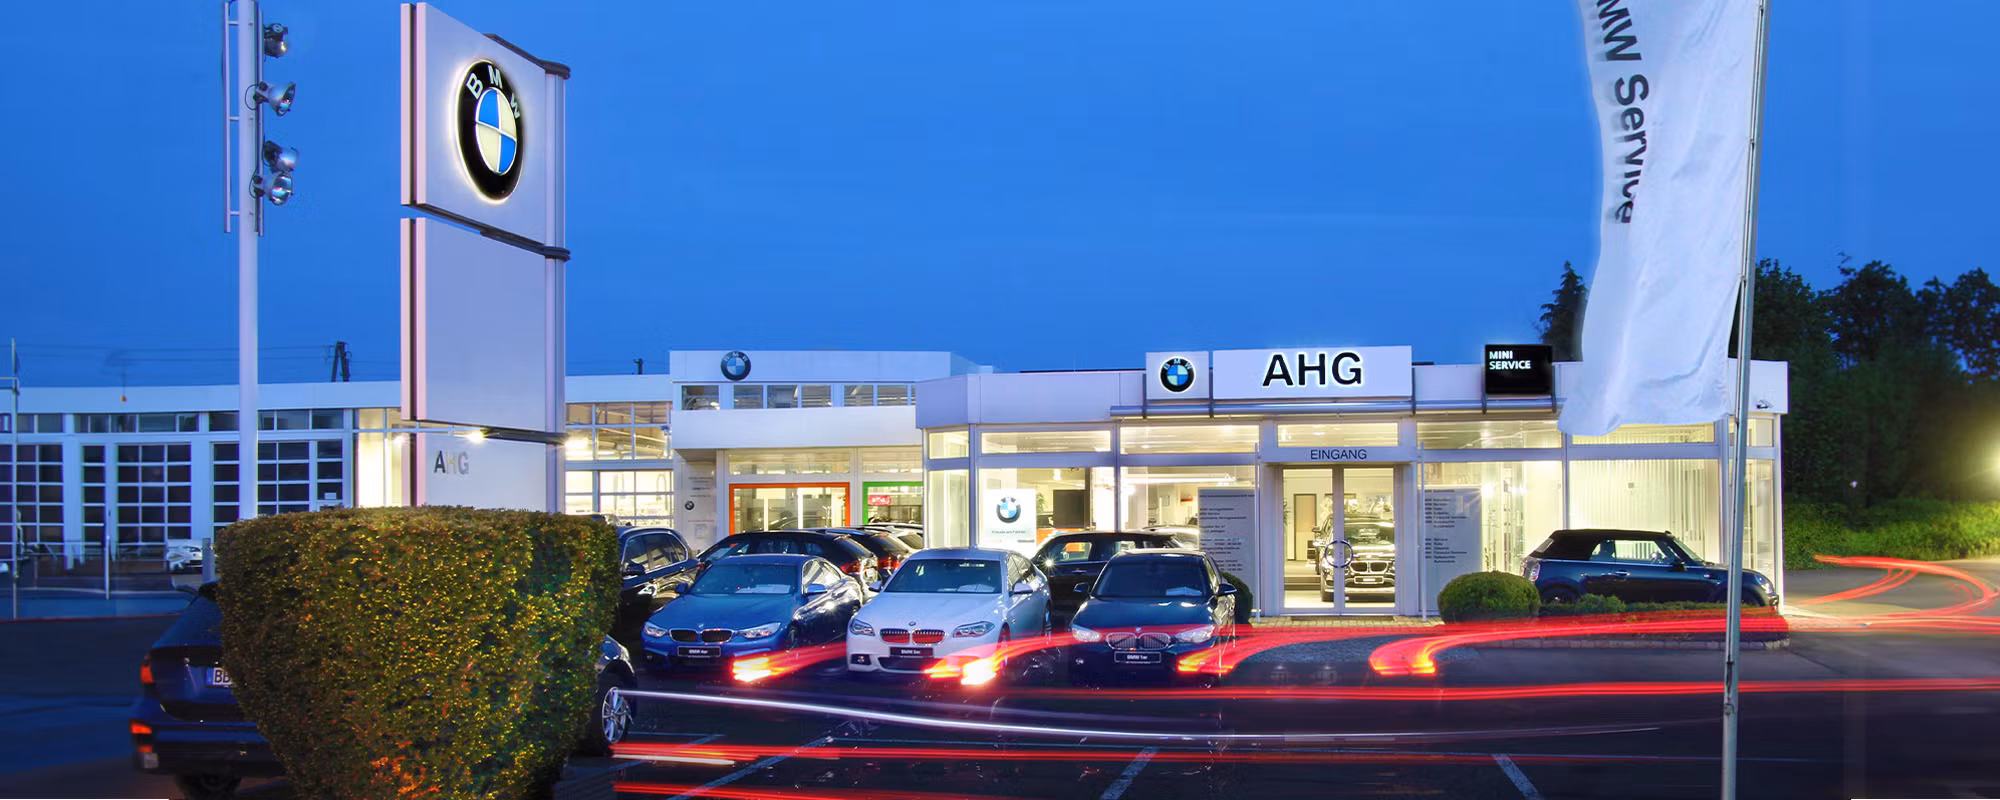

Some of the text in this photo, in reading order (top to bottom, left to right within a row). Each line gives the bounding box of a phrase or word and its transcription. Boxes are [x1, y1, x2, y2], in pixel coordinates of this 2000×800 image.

[466, 65, 521, 119] BMW
[1614, 74, 1649, 223] Service
[1163, 358, 1192, 370] BMW
[1489, 350, 1514, 360] MINI
[1262, 352, 1362, 386] AHG
[1489, 360, 1532, 370] SERVICE
[434, 450, 469, 475] AHG
[1310, 449, 1368, 460] EINGANG
